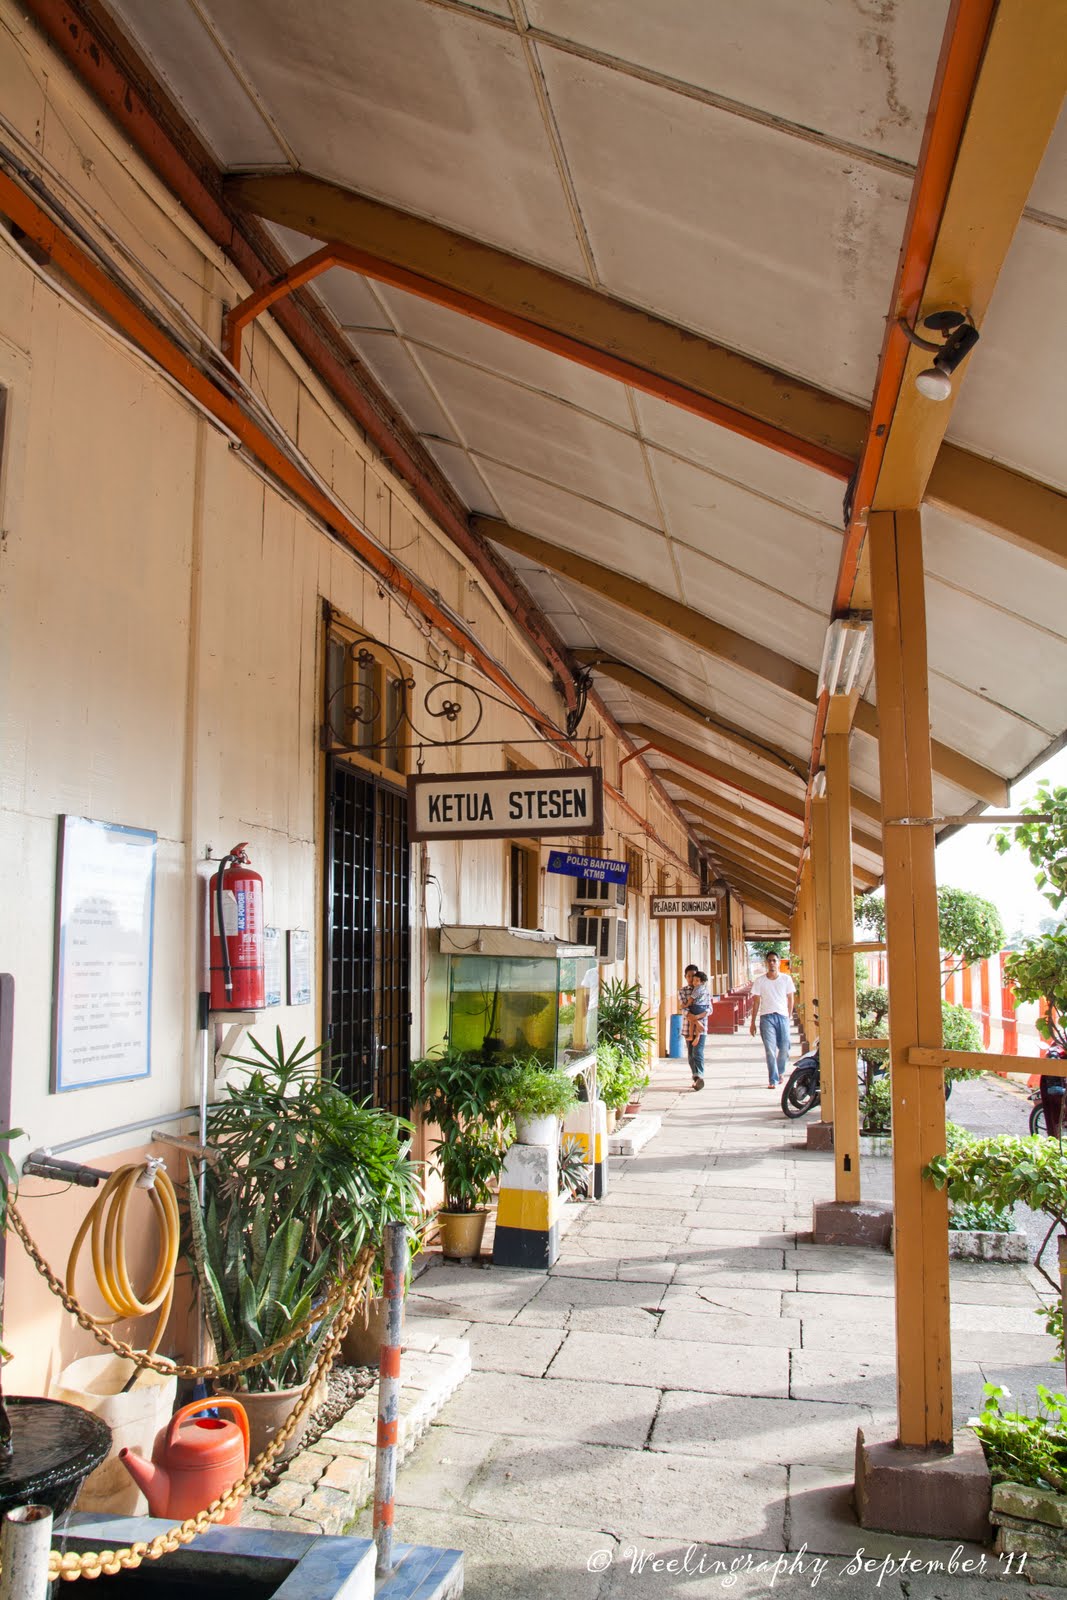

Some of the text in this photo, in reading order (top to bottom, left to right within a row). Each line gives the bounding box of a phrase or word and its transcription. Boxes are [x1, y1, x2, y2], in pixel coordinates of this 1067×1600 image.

[428, 788, 587, 823] KETUA STESEN
[566, 855, 627, 873] POLIS BANTUAN
[583, 868, 606, 880] KTMB
[237, 892, 246, 930] ABC POWDER
[653, 901, 717, 913] PEJABAT BUNGKUSAN
